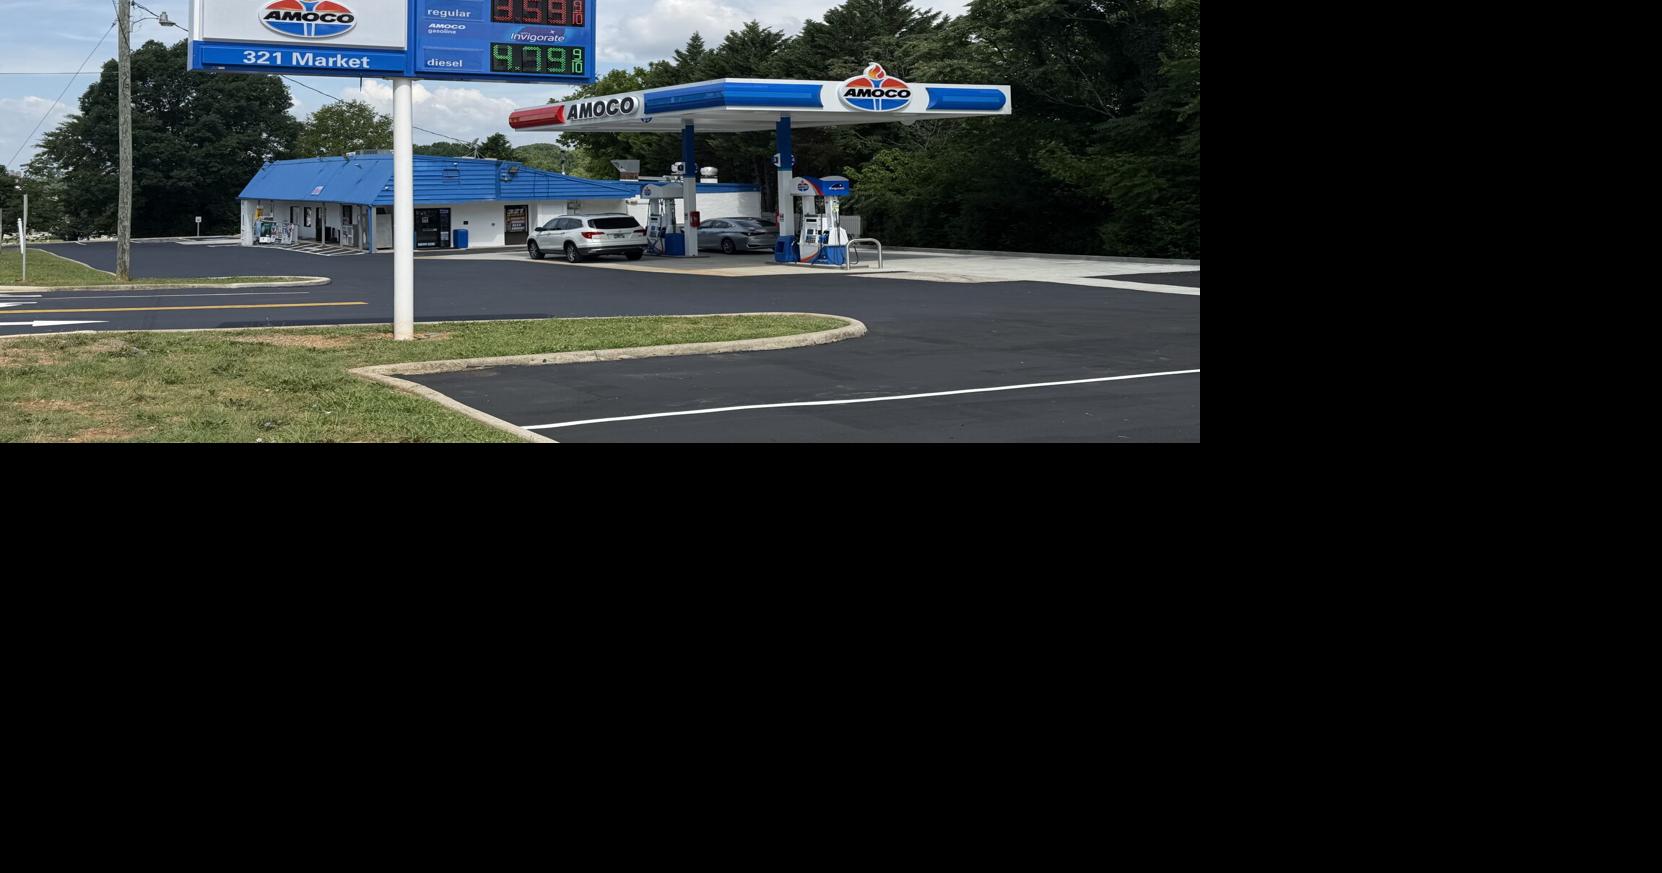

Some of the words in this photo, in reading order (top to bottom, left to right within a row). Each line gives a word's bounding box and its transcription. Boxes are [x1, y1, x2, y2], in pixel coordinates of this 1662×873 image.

[263, 10, 355, 24] AMOCO
[427, 9, 471, 18] regular
[510, 32, 565, 43] Invigorate
[243, 50, 282, 65] 321
[291, 52, 370, 69] Market
[427, 58, 464, 68] diesel
[493, 44, 566, 73] 4.79
[843, 88, 911, 98] AMOCO
[566, 96, 635, 121] AMOCO
